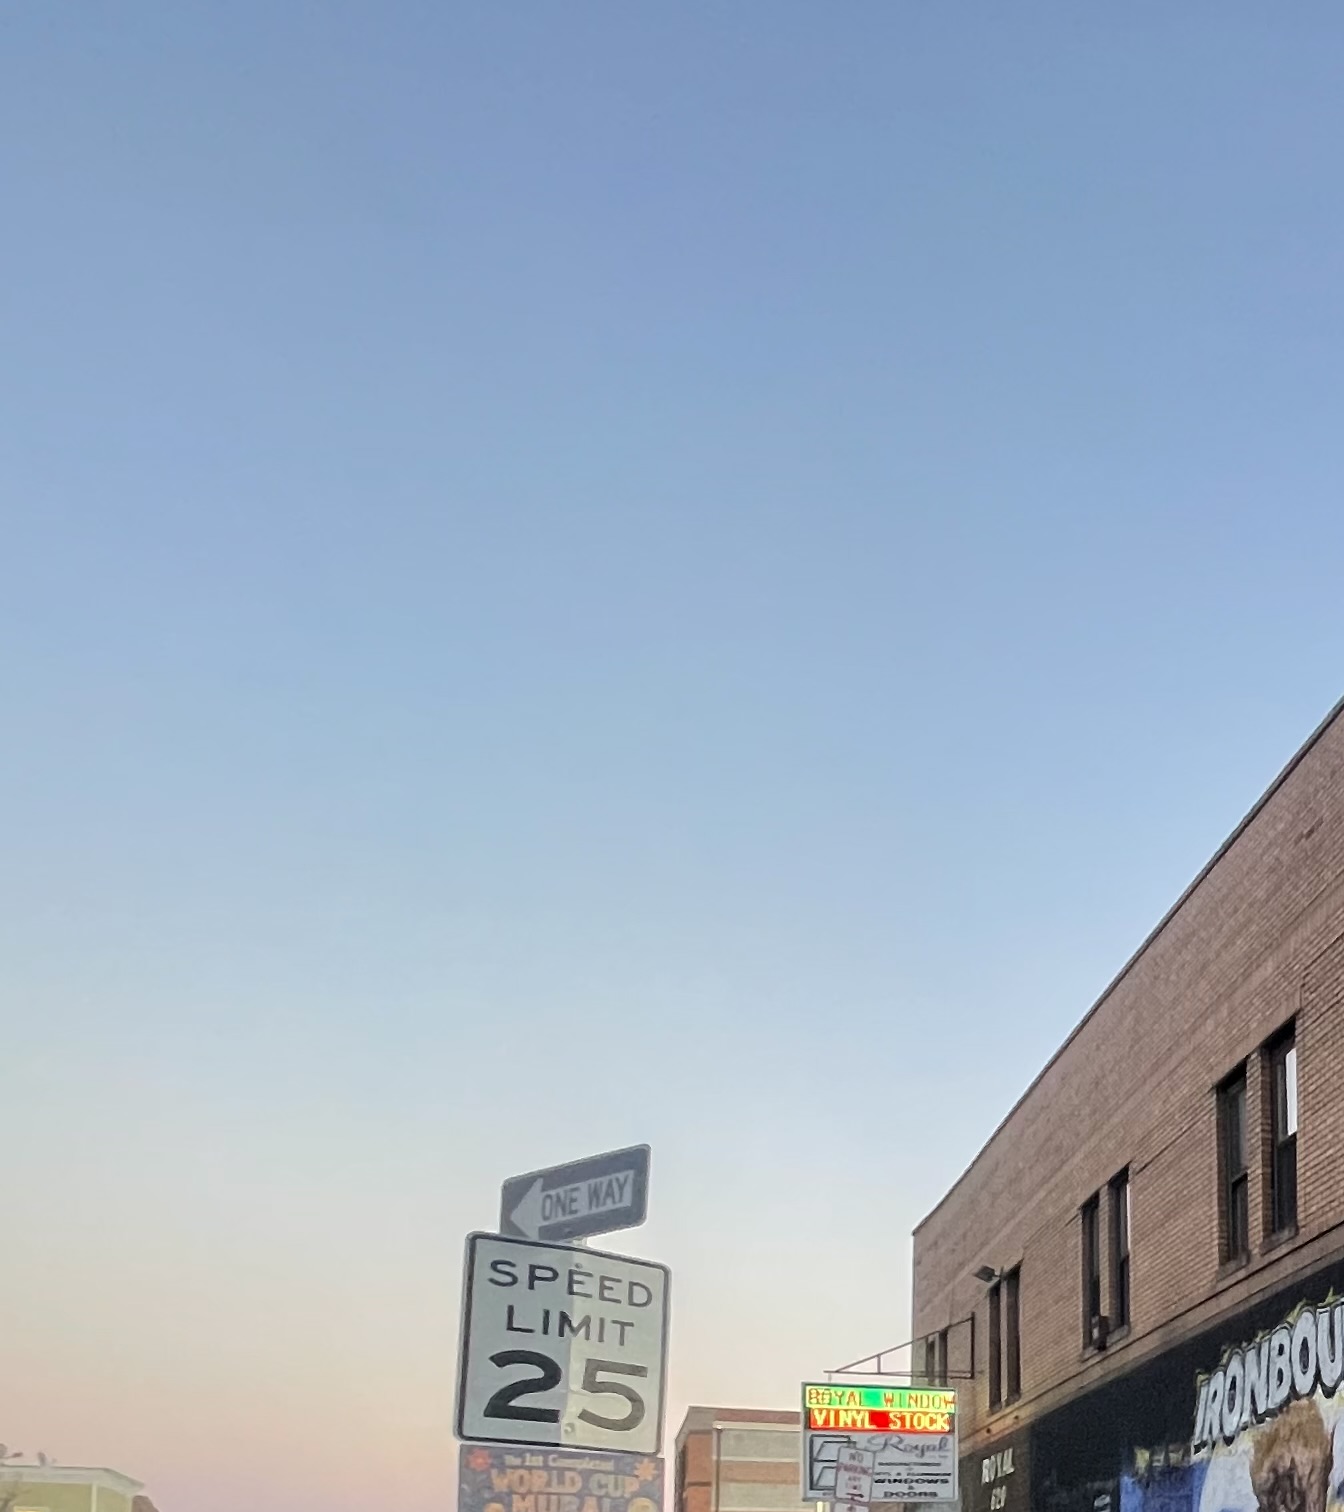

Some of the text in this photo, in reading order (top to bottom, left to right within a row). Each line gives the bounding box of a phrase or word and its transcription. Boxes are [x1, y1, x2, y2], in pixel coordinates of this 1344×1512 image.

[541, 1175, 629, 1220] ONE WAY
[488, 1259, 653, 1307] SPEED
[506, 1304, 635, 1346] LIMIT
[483, 1350, 648, 1431] 25
[813, 1409, 950, 1431] VINYL STOCK
[490, 1468, 640, 1497] WORLD CUP
[884, 1491, 938, 1499] DOORS
